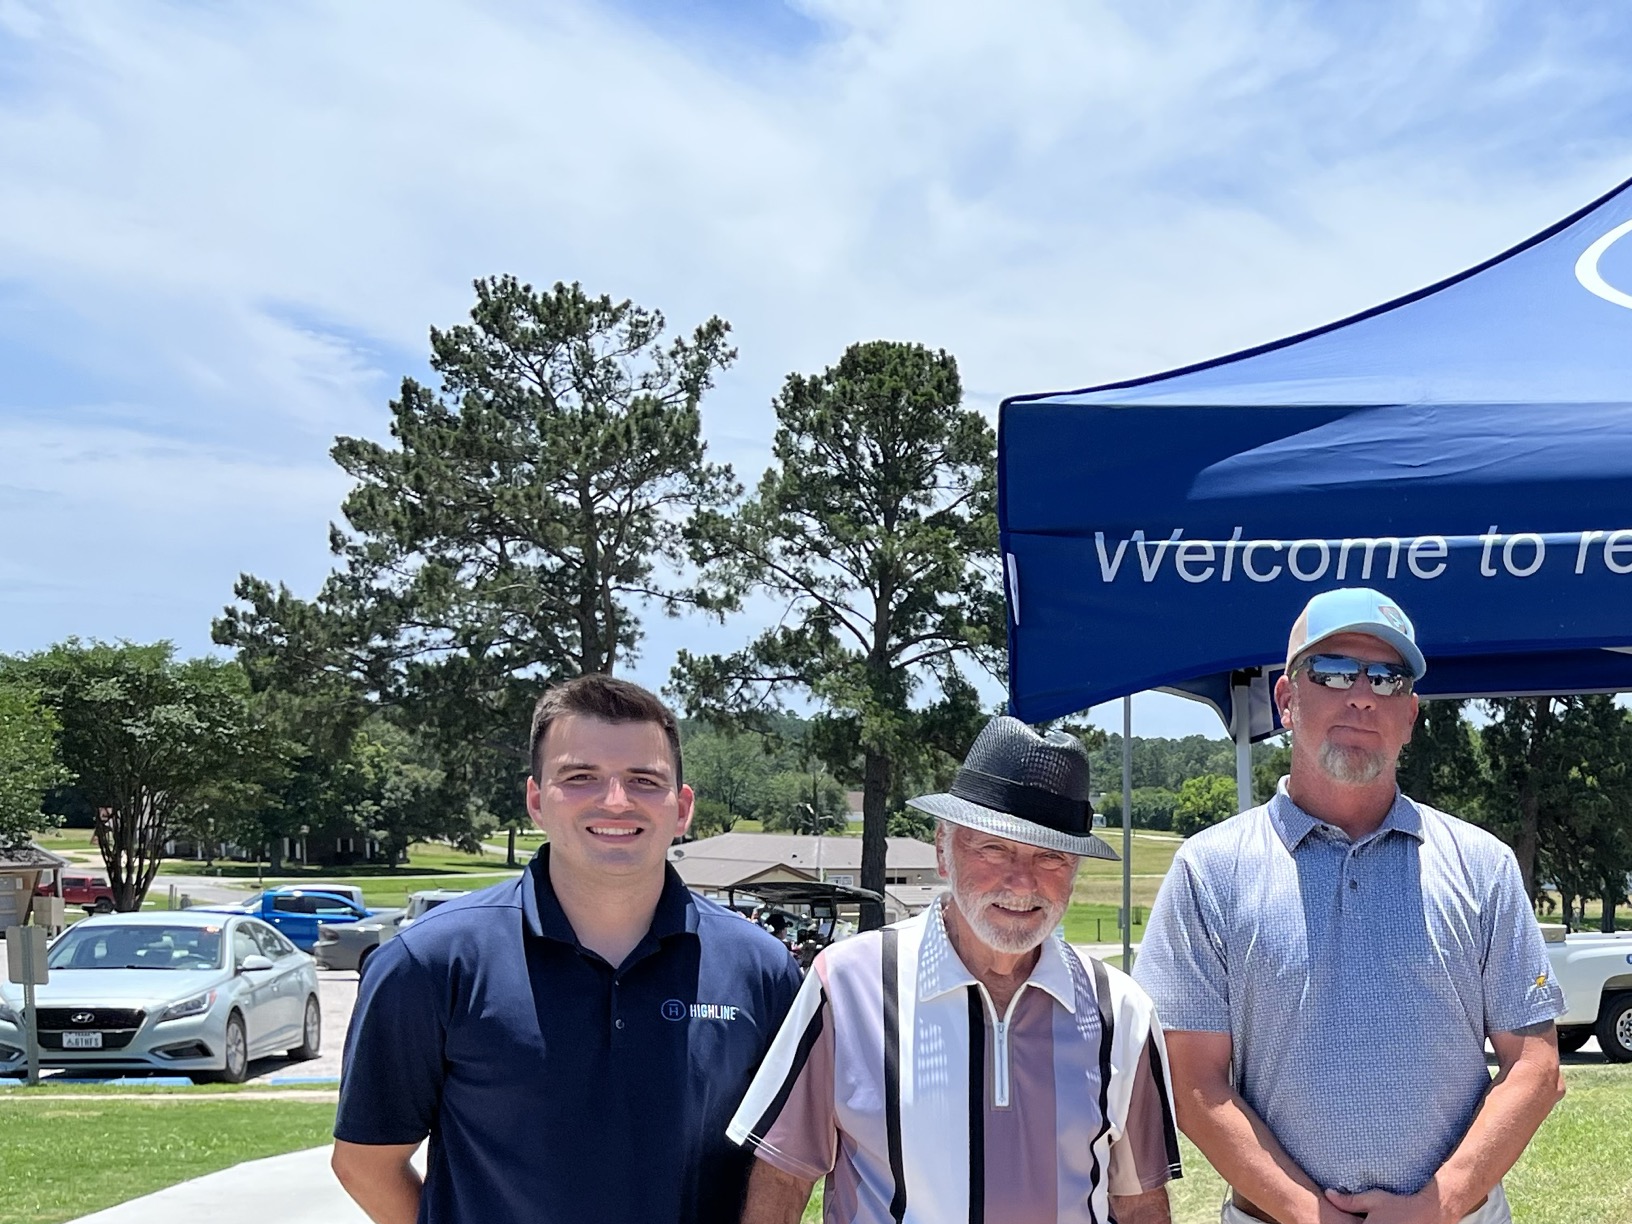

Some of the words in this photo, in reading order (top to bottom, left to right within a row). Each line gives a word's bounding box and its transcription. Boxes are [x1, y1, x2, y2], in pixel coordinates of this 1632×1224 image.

[1094, 526, 1448, 583] Welcome
[1478, 525, 1546, 577] to
[689, 1003, 737, 1021] HIGHLINE
